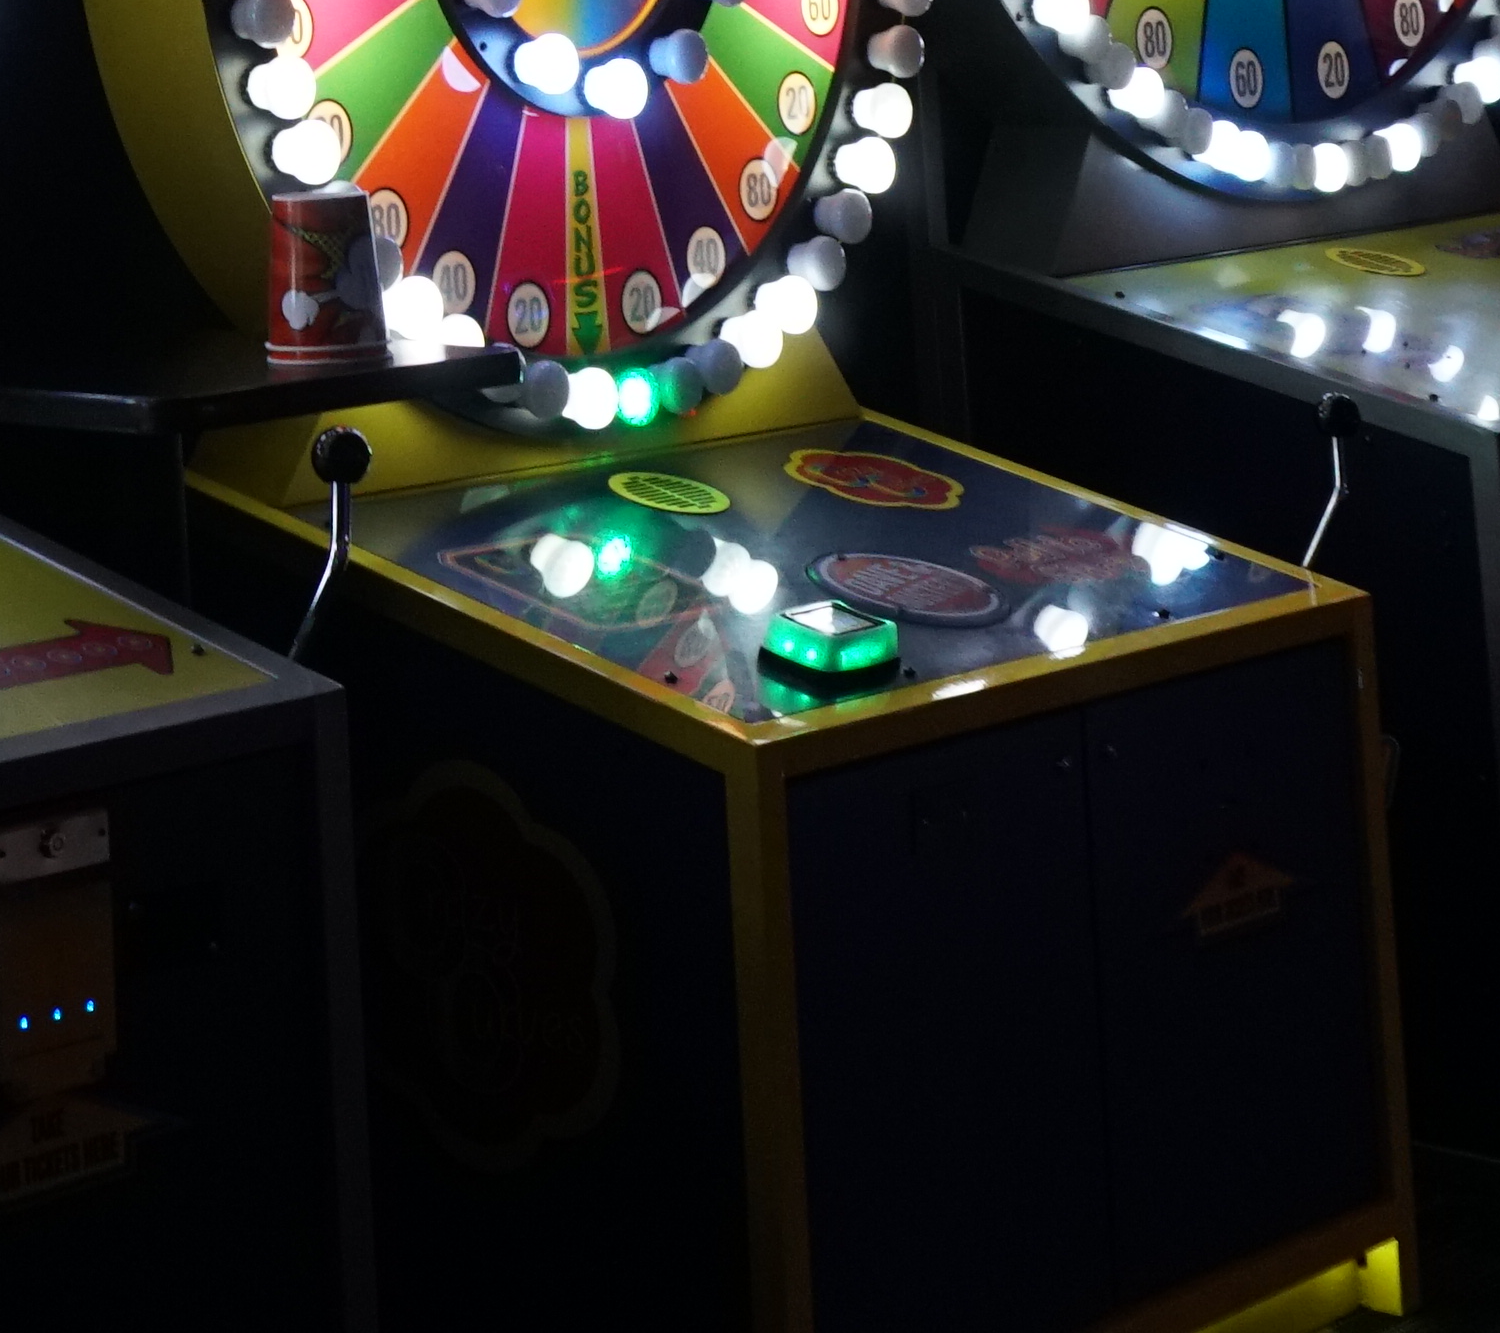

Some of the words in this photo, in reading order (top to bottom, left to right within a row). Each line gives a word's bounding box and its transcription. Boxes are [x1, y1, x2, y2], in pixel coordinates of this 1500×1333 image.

[1400, 3, 1419, 36] 80
[1144, 21, 1167, 58] 80
[1235, 61, 1257, 97] 60
[1323, 52, 1344, 87] 20
[786, 85, 810, 118] 20
[747, 174, 771, 207] 80
[573, 171, 599, 309] BONUS
[694, 239, 718, 275] 40
[441, 264, 467, 298] 40
[515, 297, 540, 333] 20
